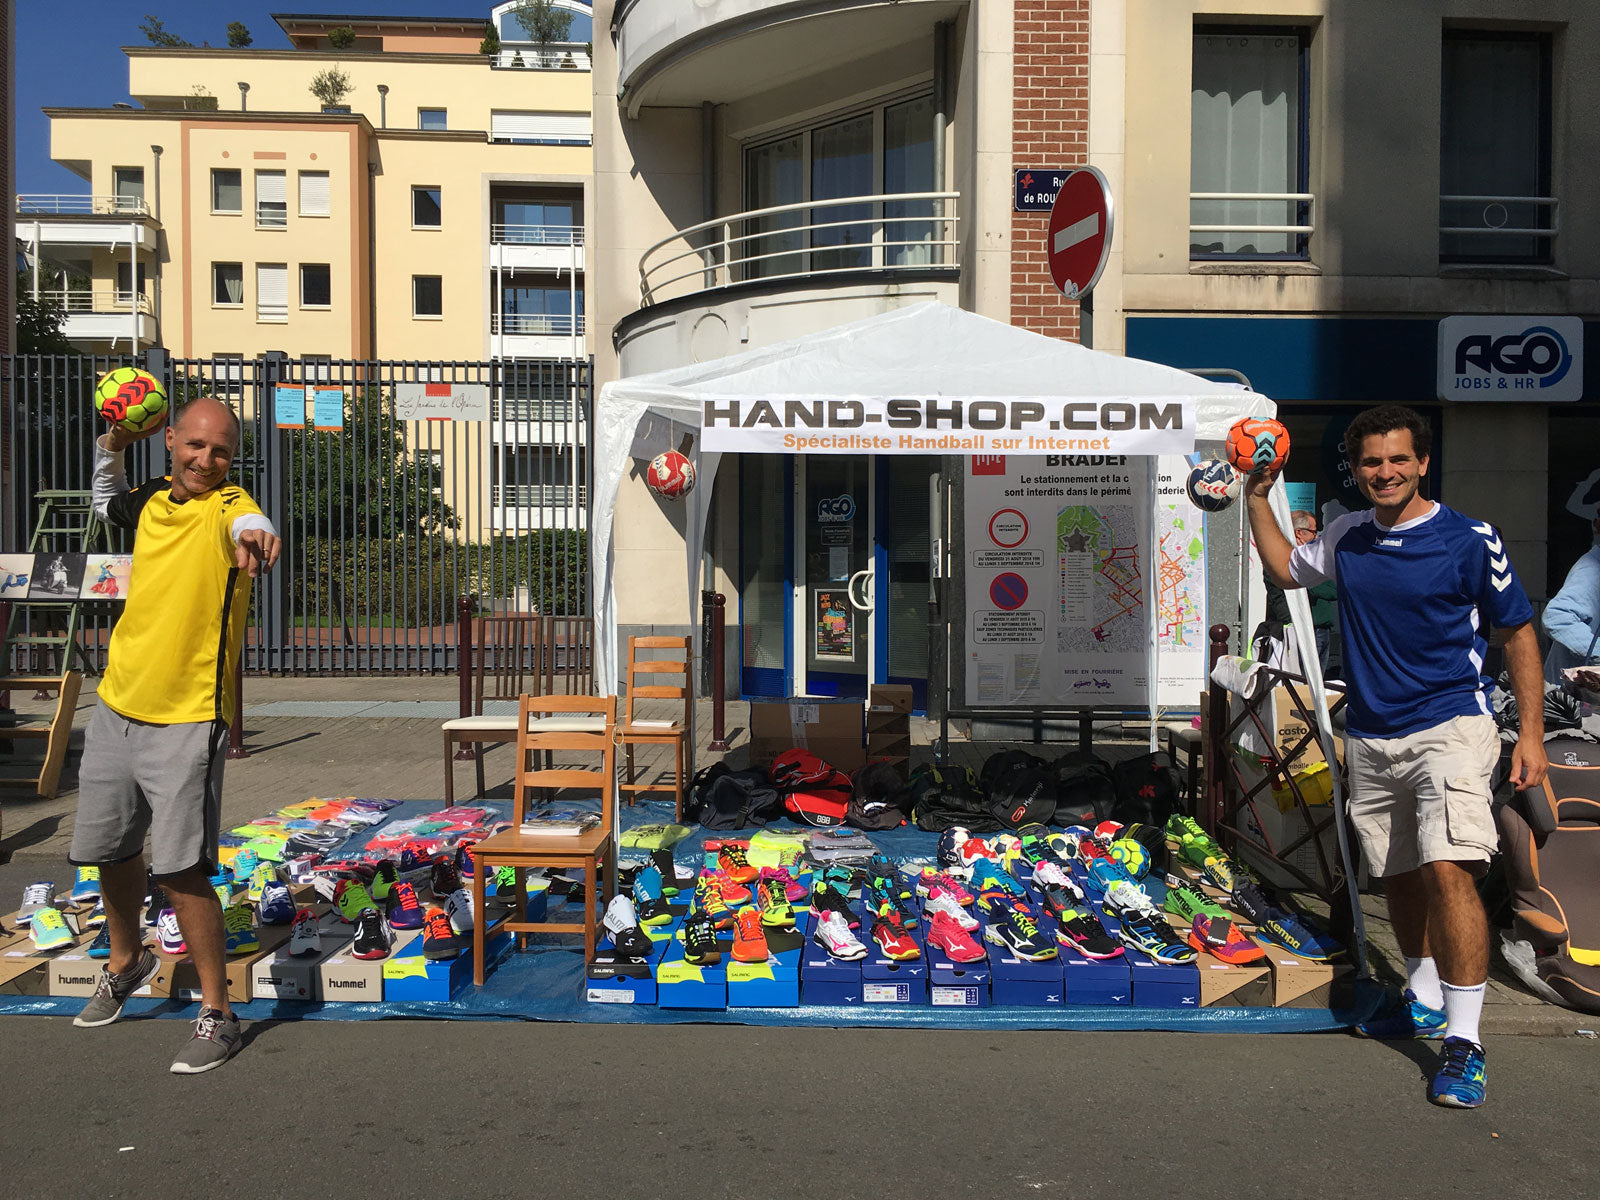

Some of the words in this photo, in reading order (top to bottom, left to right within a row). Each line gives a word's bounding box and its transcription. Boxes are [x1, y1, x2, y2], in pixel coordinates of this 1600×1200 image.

[1053, 177, 1064, 187] Ru
[1024, 193, 1034, 203] de
[1037, 193, 1056, 203] ROU
[1455, 335, 1561, 375] AGO
[1454, 377, 1491, 389] JOBS
[1497, 377, 1508, 389] &
[1515, 377, 1534, 389] HR
[440, 399, 448, 408] de
[704, 400, 1183, 431] HAND-SHOP.COM
[783, 433, 892, 451] Spécialiste
[898, 433, 985, 451] Handball
[992, 437, 1023, 450] sur
[1028, 435, 1111, 451] Internet
[1021, 474, 1032, 484] Le
[1034, 474, 1098, 484] stationnement
[1100, 474, 1111, 484] et
[1112, 474, 1123, 484] la
[1005, 488, 1024, 497] sont
[1026, 488, 1064, 497] interdits
[1066, 488, 1088, 497] dans
[1090, 488, 1099, 497] le
[819, 499, 851, 515] AGO
[1375, 537, 1403, 547] hummel
[1278, 726, 1308, 736] casto
[1267, 919, 1301, 950] Kempa
[1207, 935, 1227, 945] Kempa
[58, 974, 96, 985] hummel
[328, 978, 366, 989] hummel
